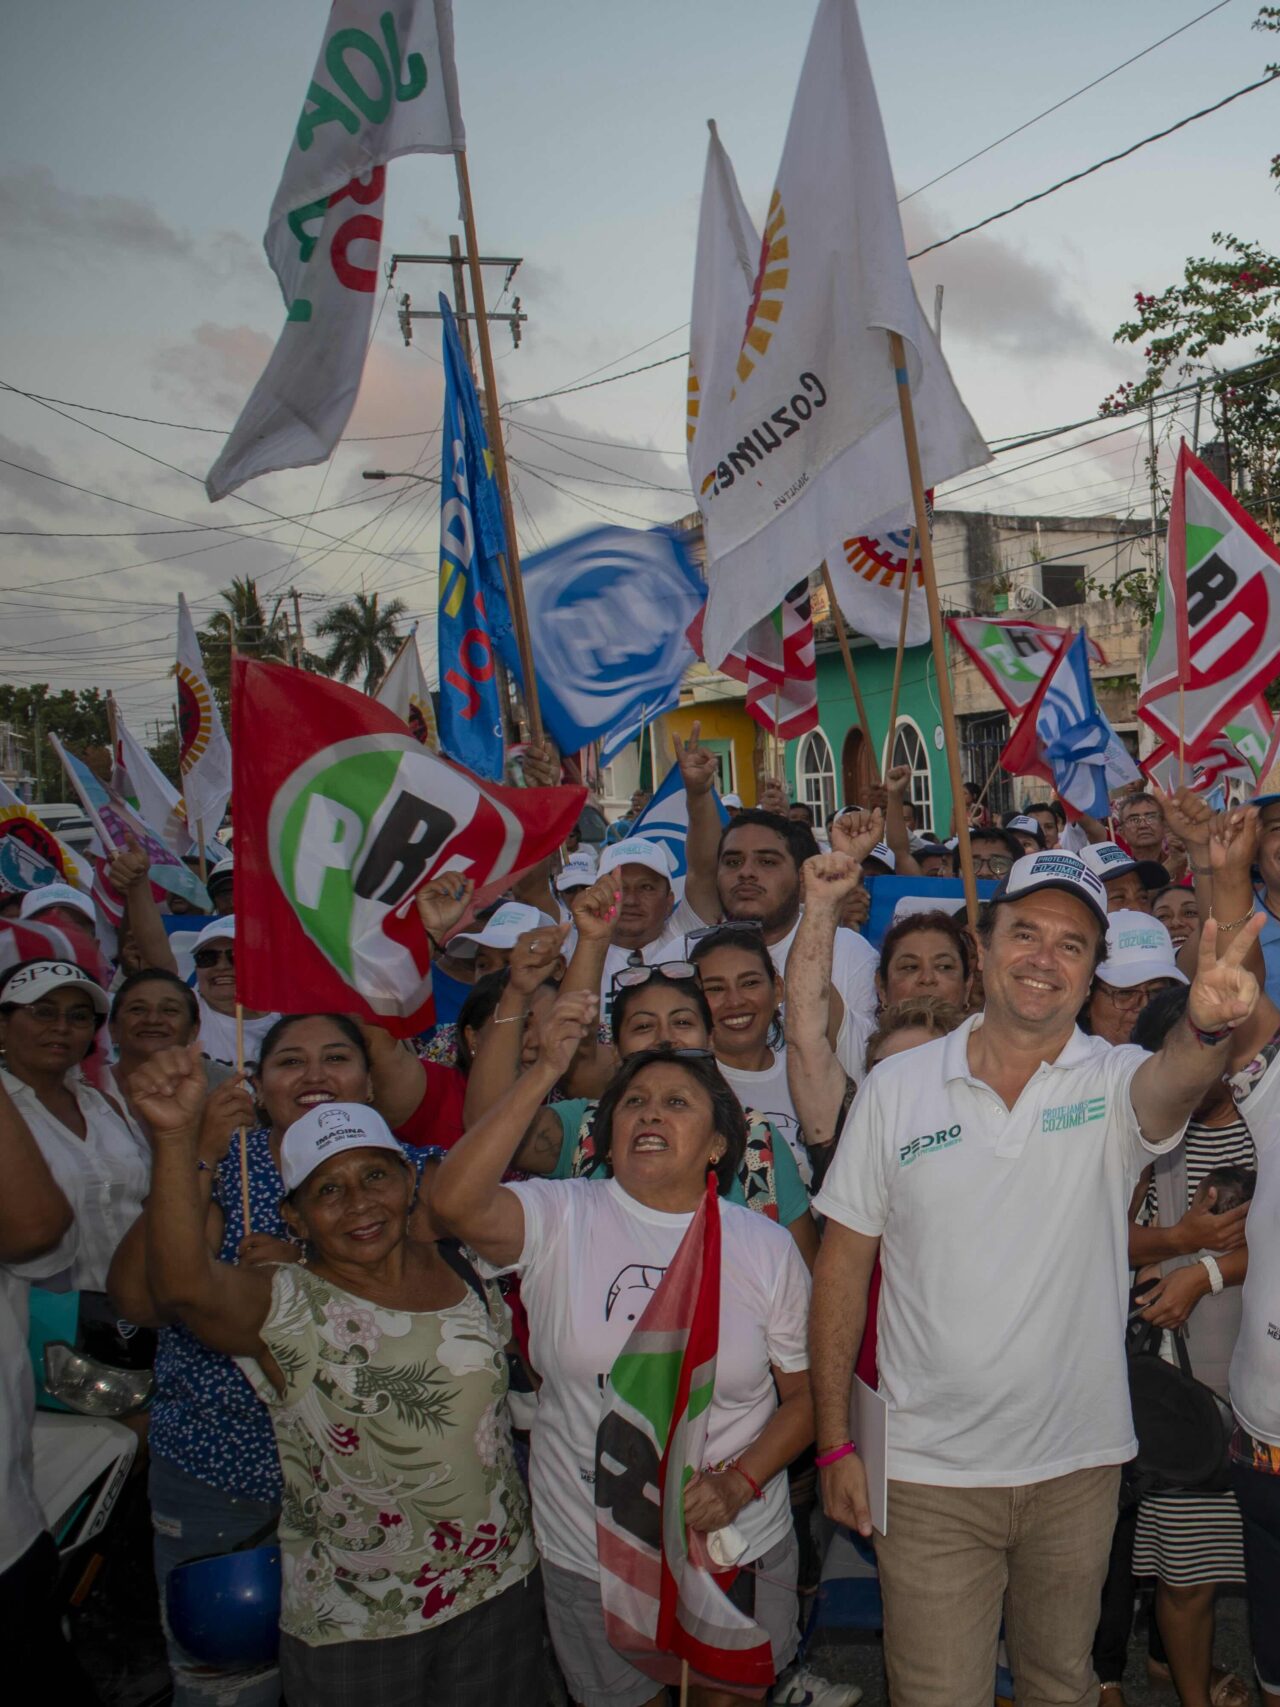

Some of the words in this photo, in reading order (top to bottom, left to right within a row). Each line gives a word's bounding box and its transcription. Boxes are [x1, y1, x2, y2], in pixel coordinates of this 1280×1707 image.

[1187, 552, 1255, 674] RI
[1037, 855, 1084, 869] PROTEJAMOS
[1033, 865, 1081, 879] COZUMEL
[1043, 1102, 1089, 1119] PROTEJAMOS
[1042, 1112, 1087, 1133] COZUMEL
[315, 1128, 366, 1146] IMAGINA
[900, 1124, 962, 1161] PEDRO
